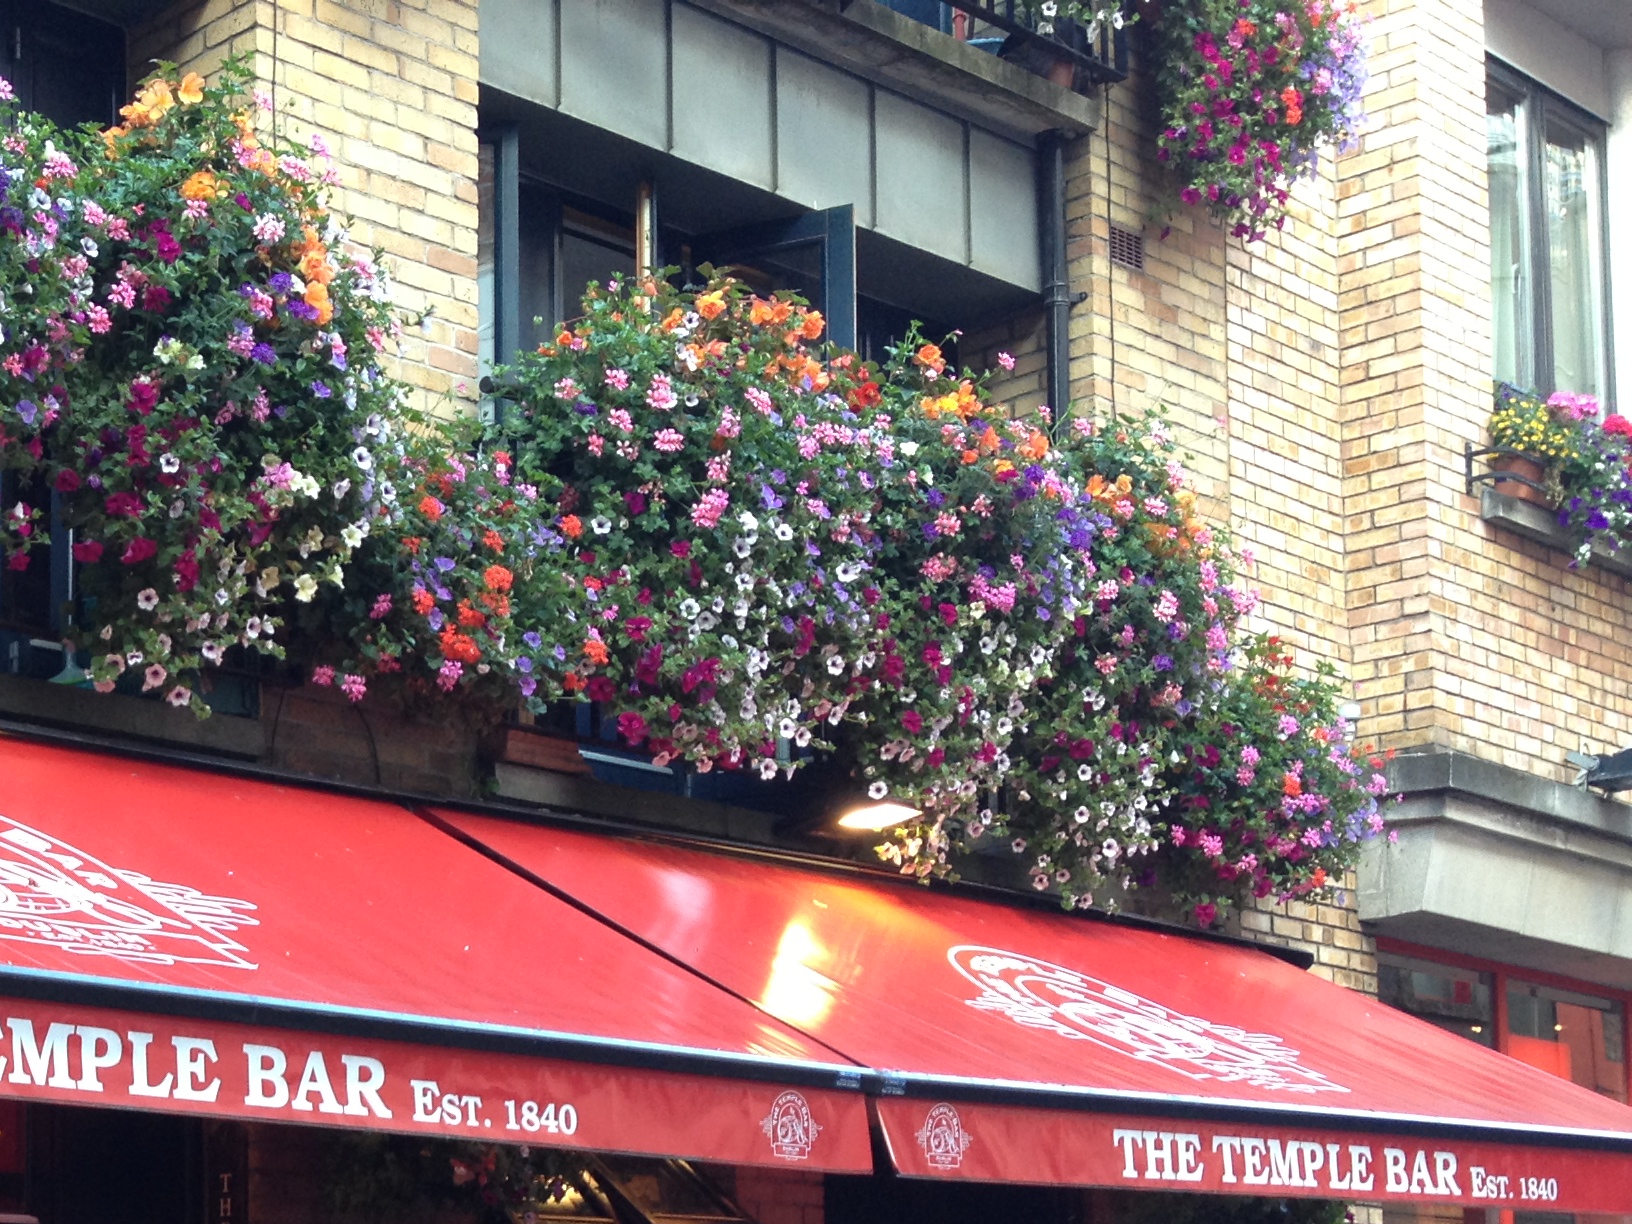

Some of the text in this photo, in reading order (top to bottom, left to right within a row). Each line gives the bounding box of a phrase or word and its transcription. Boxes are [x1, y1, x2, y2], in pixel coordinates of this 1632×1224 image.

[242, 1043, 393, 1120] BAR
[504, 1099, 578, 1135] 1840
[1112, 1128, 1205, 1182] THE
[1211, 1134, 1375, 1192] TEMPLE
[1382, 1146, 1463, 1197] BAR
[1519, 1176, 1558, 1202] 1840
